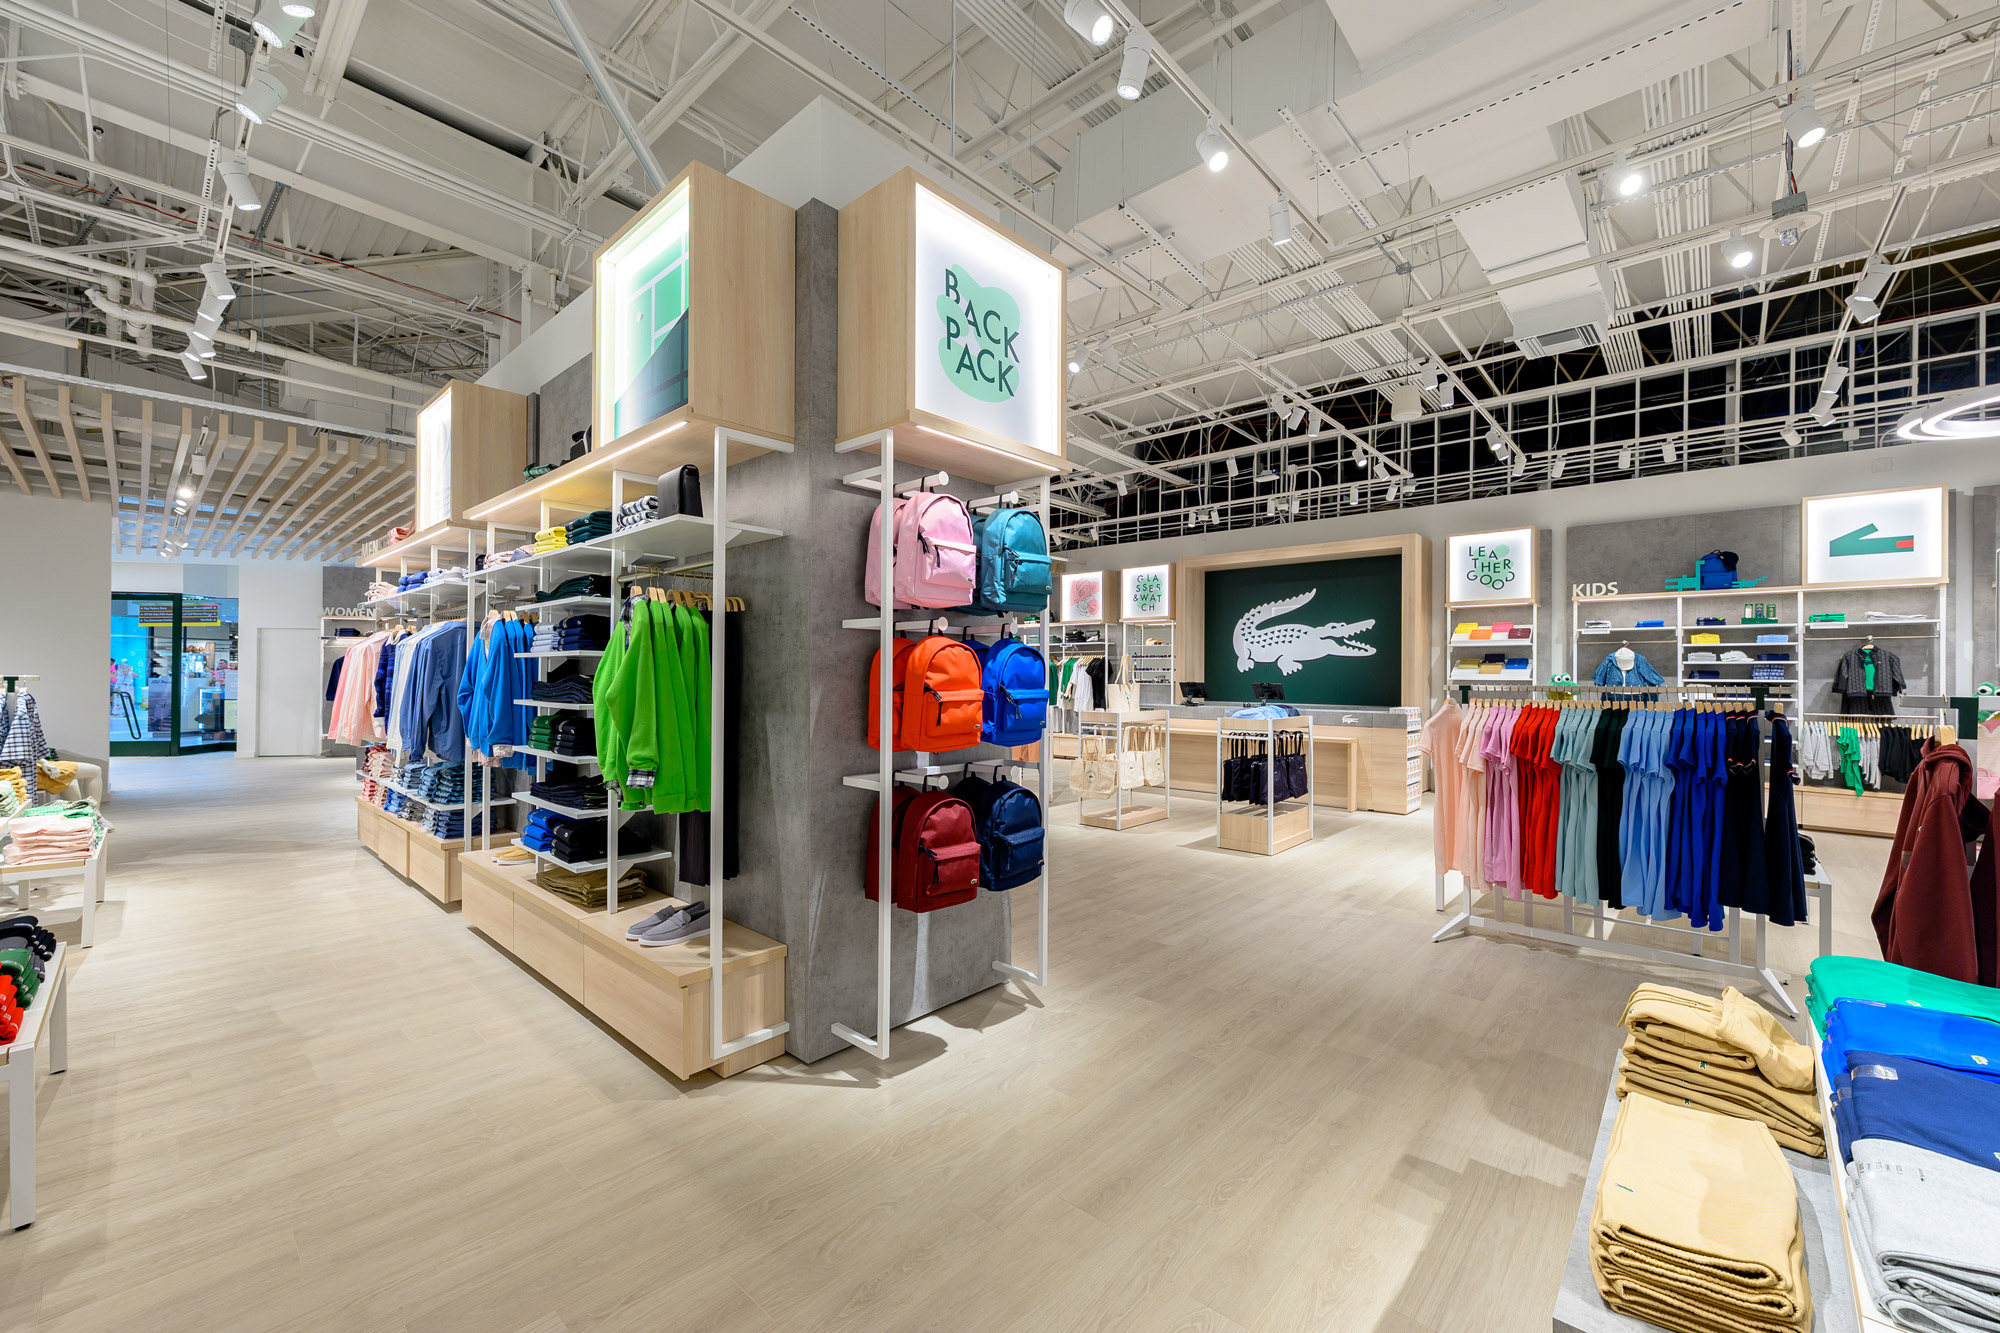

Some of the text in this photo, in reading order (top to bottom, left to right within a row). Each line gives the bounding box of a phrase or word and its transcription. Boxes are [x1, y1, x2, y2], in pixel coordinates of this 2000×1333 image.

[945, 268, 1020, 363] BACK
[946, 316, 1014, 397] PACK
[361, 539, 379, 558] MEN
[1468, 546, 1499, 560] LEA
[1471, 557, 1512, 574] THER
[1137, 574, 1159, 583] GLA
[1466, 570, 1515, 590] GOOD
[1135, 583, 1161, 592] SSES
[1572, 581, 1619, 597] KIDS
[323, 606, 376, 617] WOMEN
[1141, 603, 1155, 611] CH
